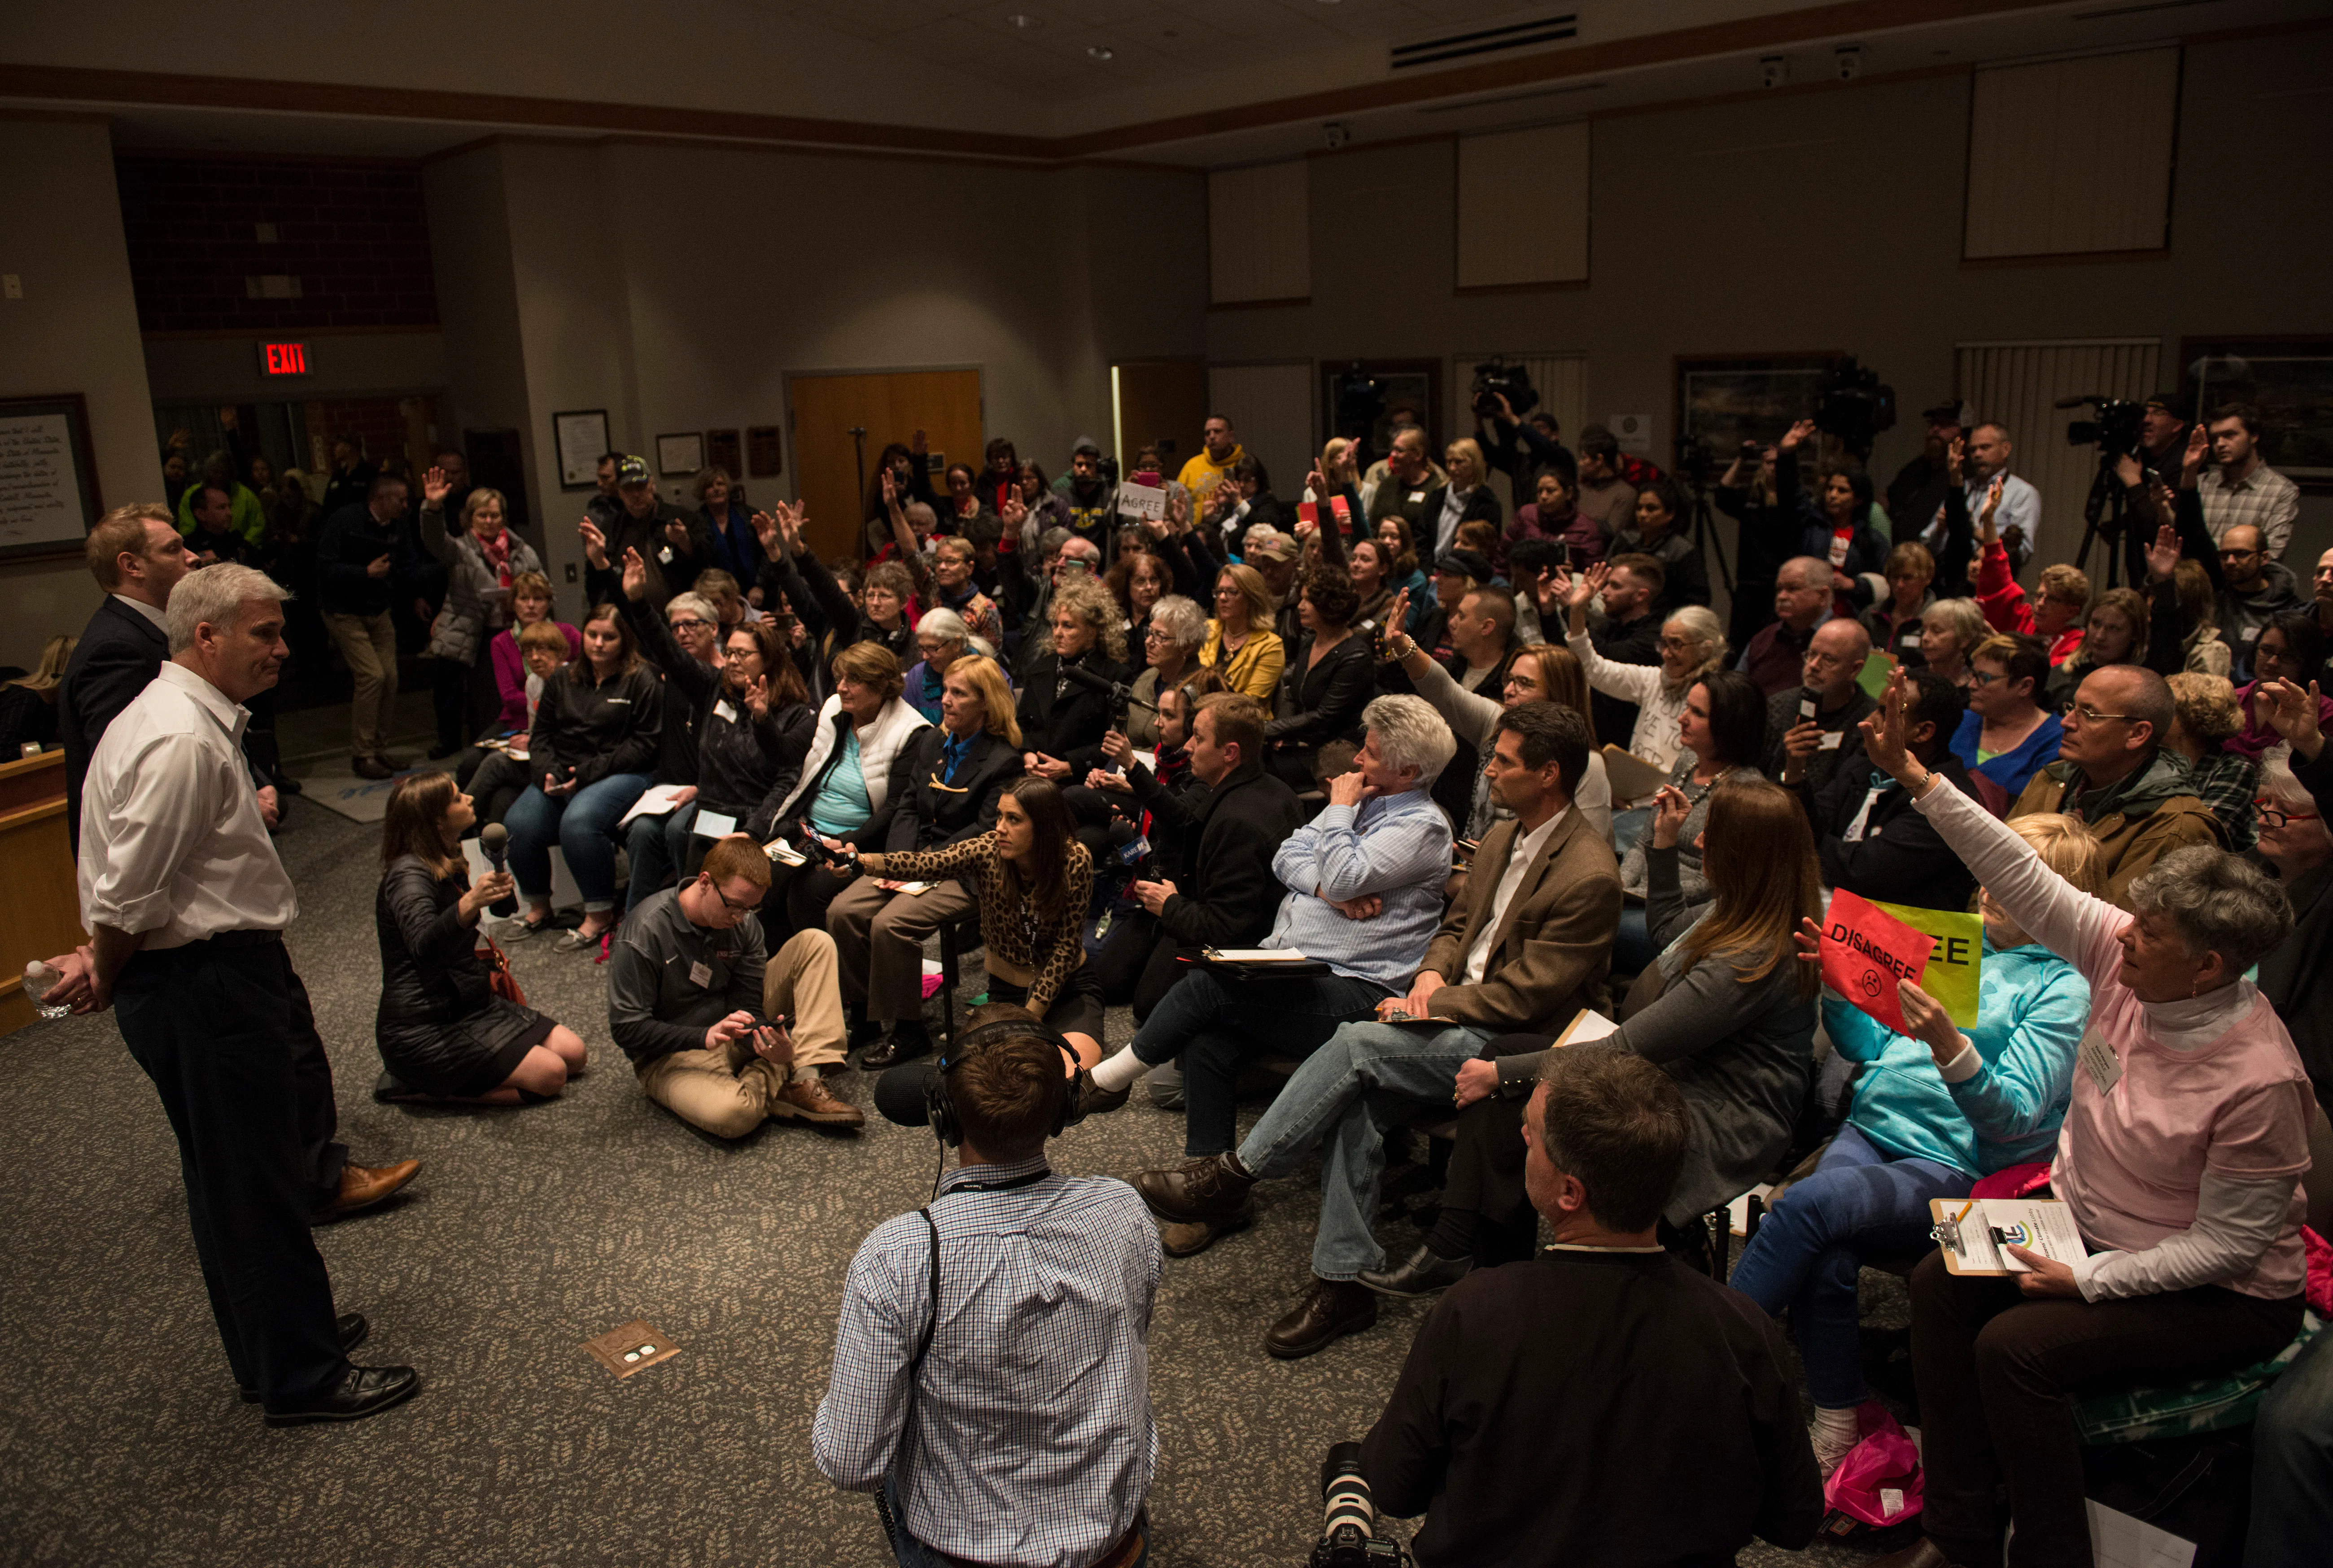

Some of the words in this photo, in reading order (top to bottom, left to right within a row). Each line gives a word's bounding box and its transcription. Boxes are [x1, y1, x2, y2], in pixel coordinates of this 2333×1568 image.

[267, 344, 305, 374] EXIT
[1122, 494, 1161, 512] AGREE
[1831, 923, 1916, 980] DISAGREE
[2027, 1208, 2036, 1222] Lobby
[2033, 1221, 2043, 1241] Climate
[2050, 1246, 2058, 1260] Political
